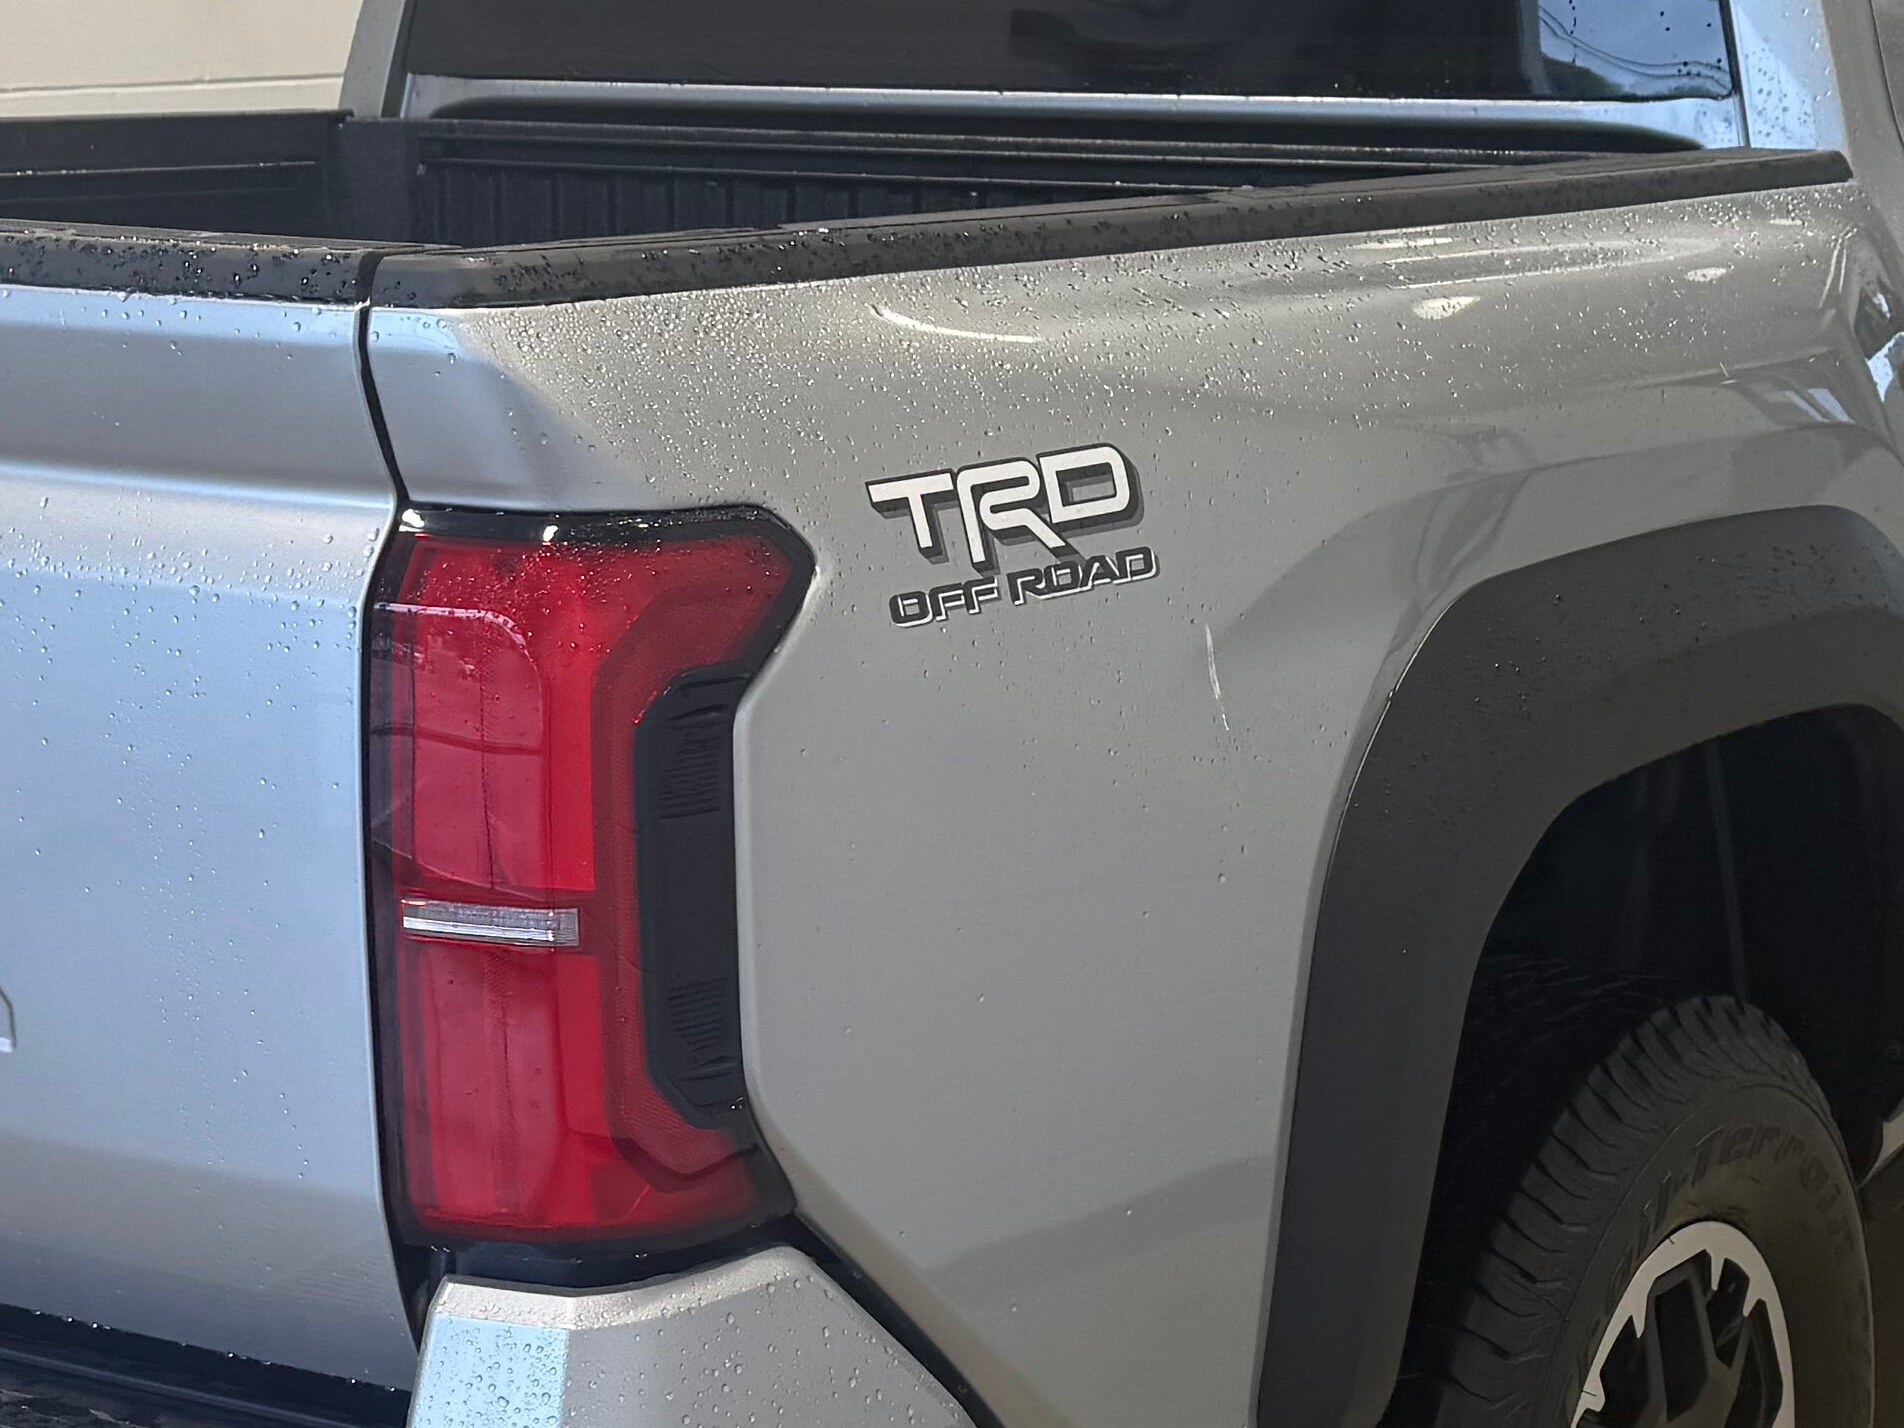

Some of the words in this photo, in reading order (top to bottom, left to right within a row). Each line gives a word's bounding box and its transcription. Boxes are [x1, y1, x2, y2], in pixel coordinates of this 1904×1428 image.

[865, 443, 1144, 578] TRD
[889, 575, 1001, 629] OFF
[1007, 546, 1161, 607] ROAD
